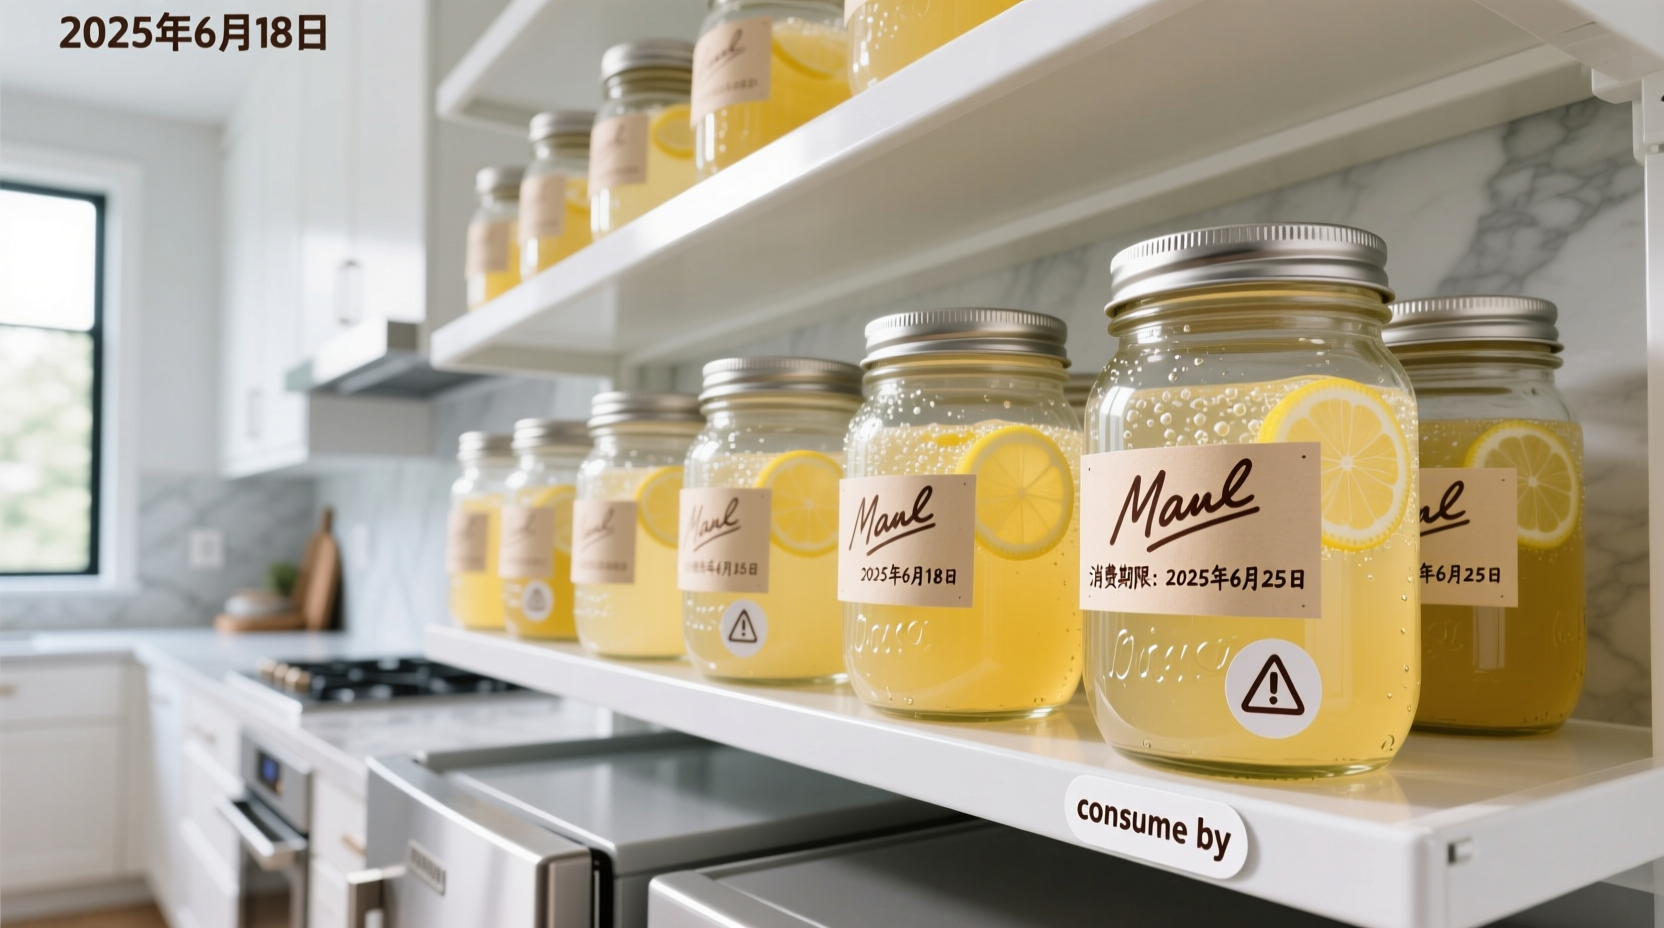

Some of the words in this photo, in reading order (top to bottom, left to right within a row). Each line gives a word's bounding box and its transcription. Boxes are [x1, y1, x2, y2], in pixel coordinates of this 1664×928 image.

[861, 564, 956, 586] 2025年6月18日
[1166, 565, 1305, 591] 2025年6月25日
[1420, 562, 1500, 584] 年6月25日
[1077, 799, 1187, 844] consume
[1197, 817, 1231, 862] by
